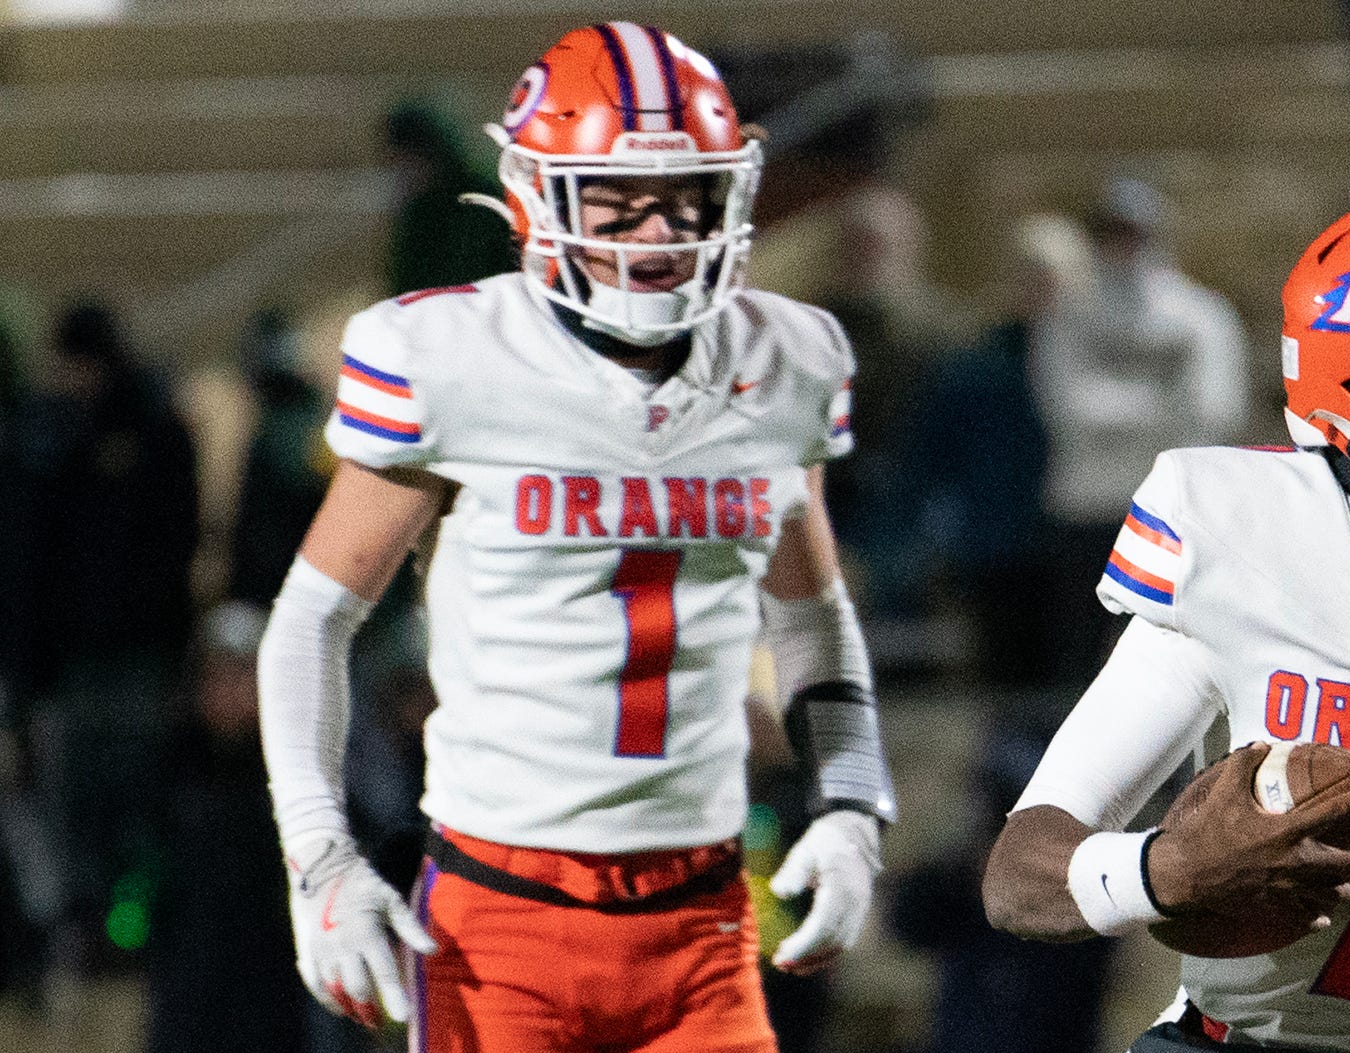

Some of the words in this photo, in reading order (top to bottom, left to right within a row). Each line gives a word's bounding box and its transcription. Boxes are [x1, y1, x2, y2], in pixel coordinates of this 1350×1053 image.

[647, 404, 670, 433] P
[516, 474, 771, 537] ORANGE
[610, 548, 684, 759] 1
